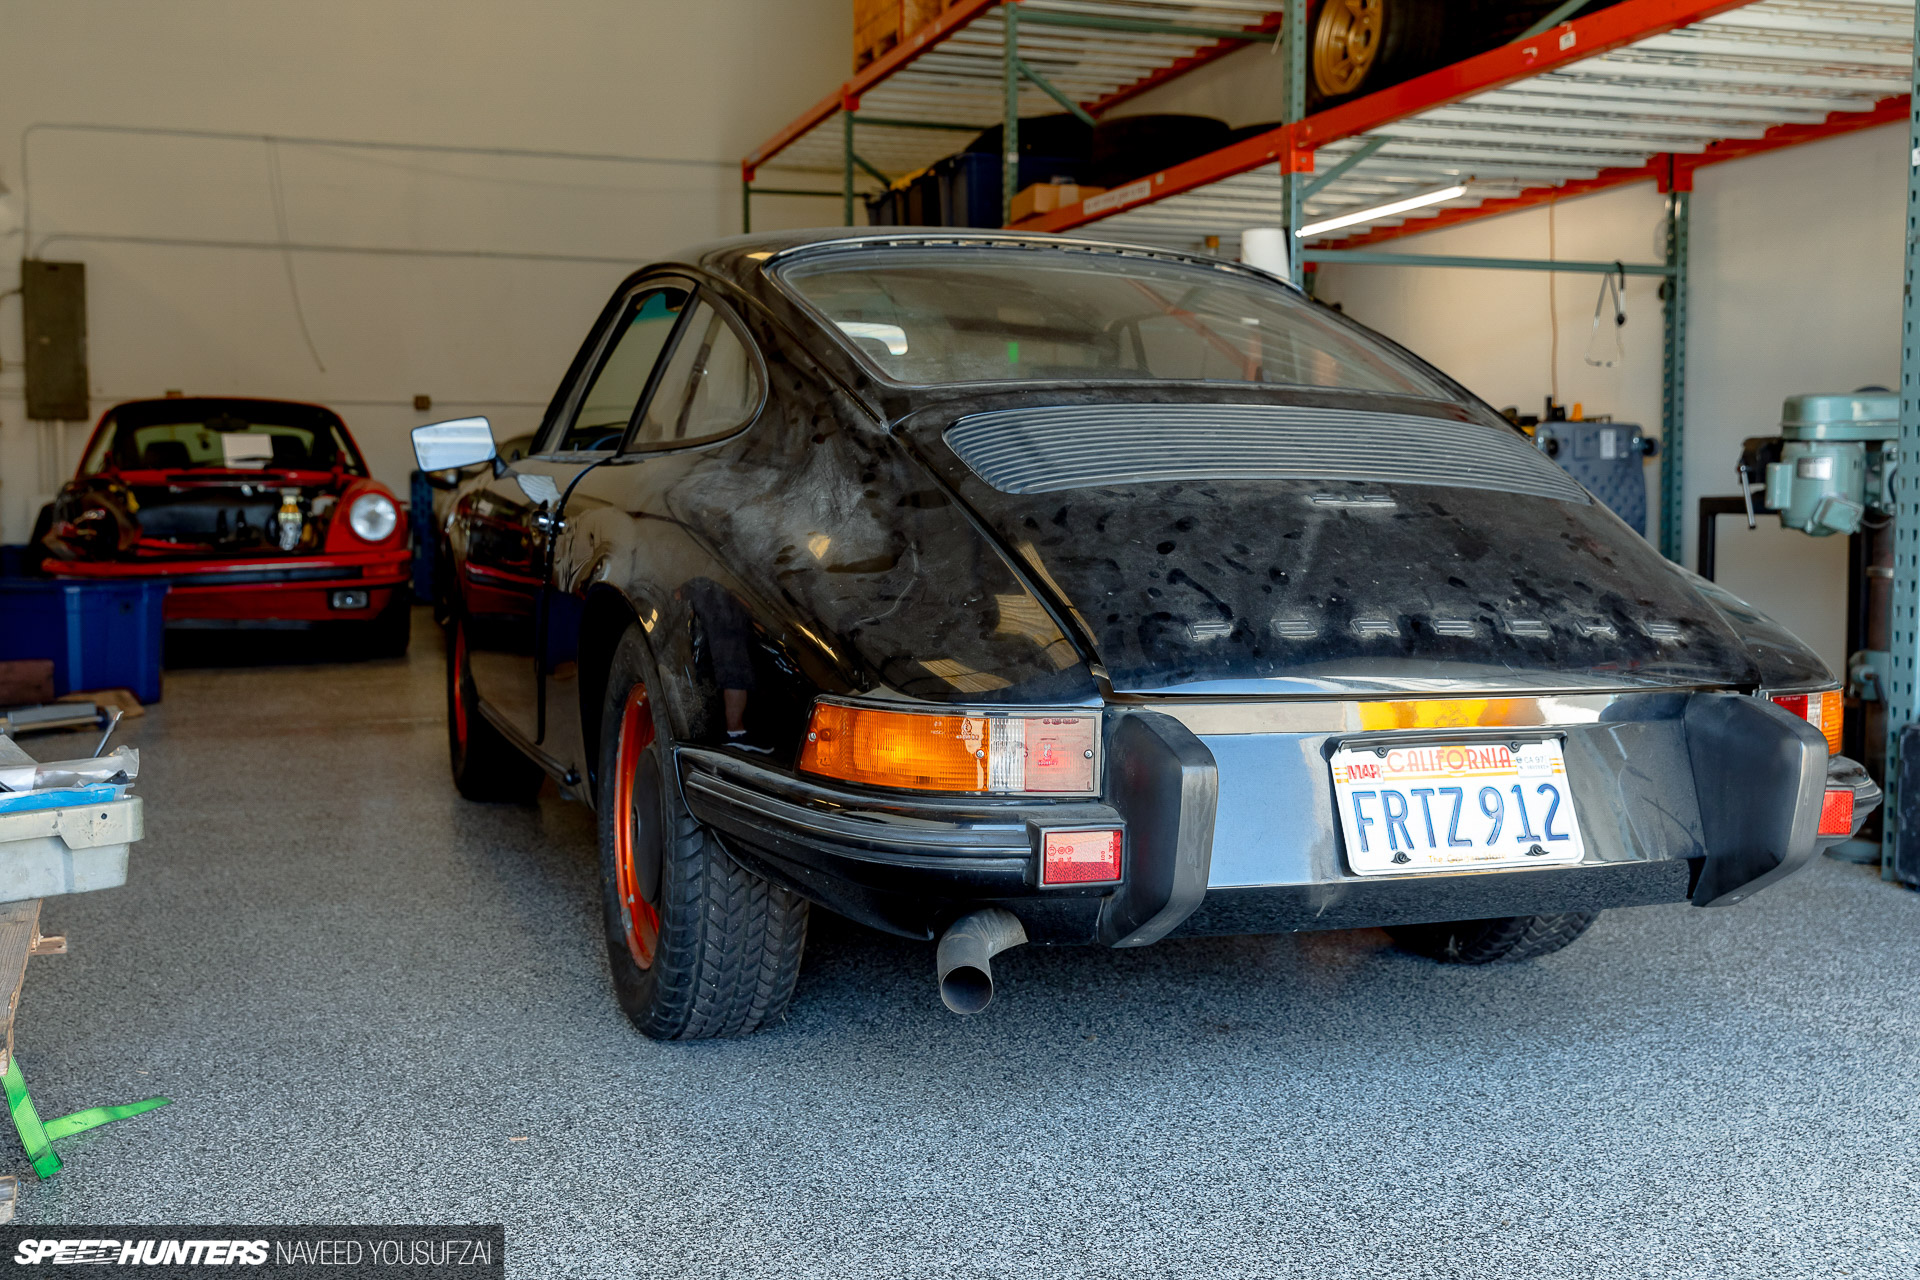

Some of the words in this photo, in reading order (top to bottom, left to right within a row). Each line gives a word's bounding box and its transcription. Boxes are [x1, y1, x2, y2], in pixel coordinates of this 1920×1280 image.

[1186, 619, 1684, 641] PORSCHE
[1386, 746, 1512, 773] CALIFORNIA
[1346, 764, 1381, 779] MAR
